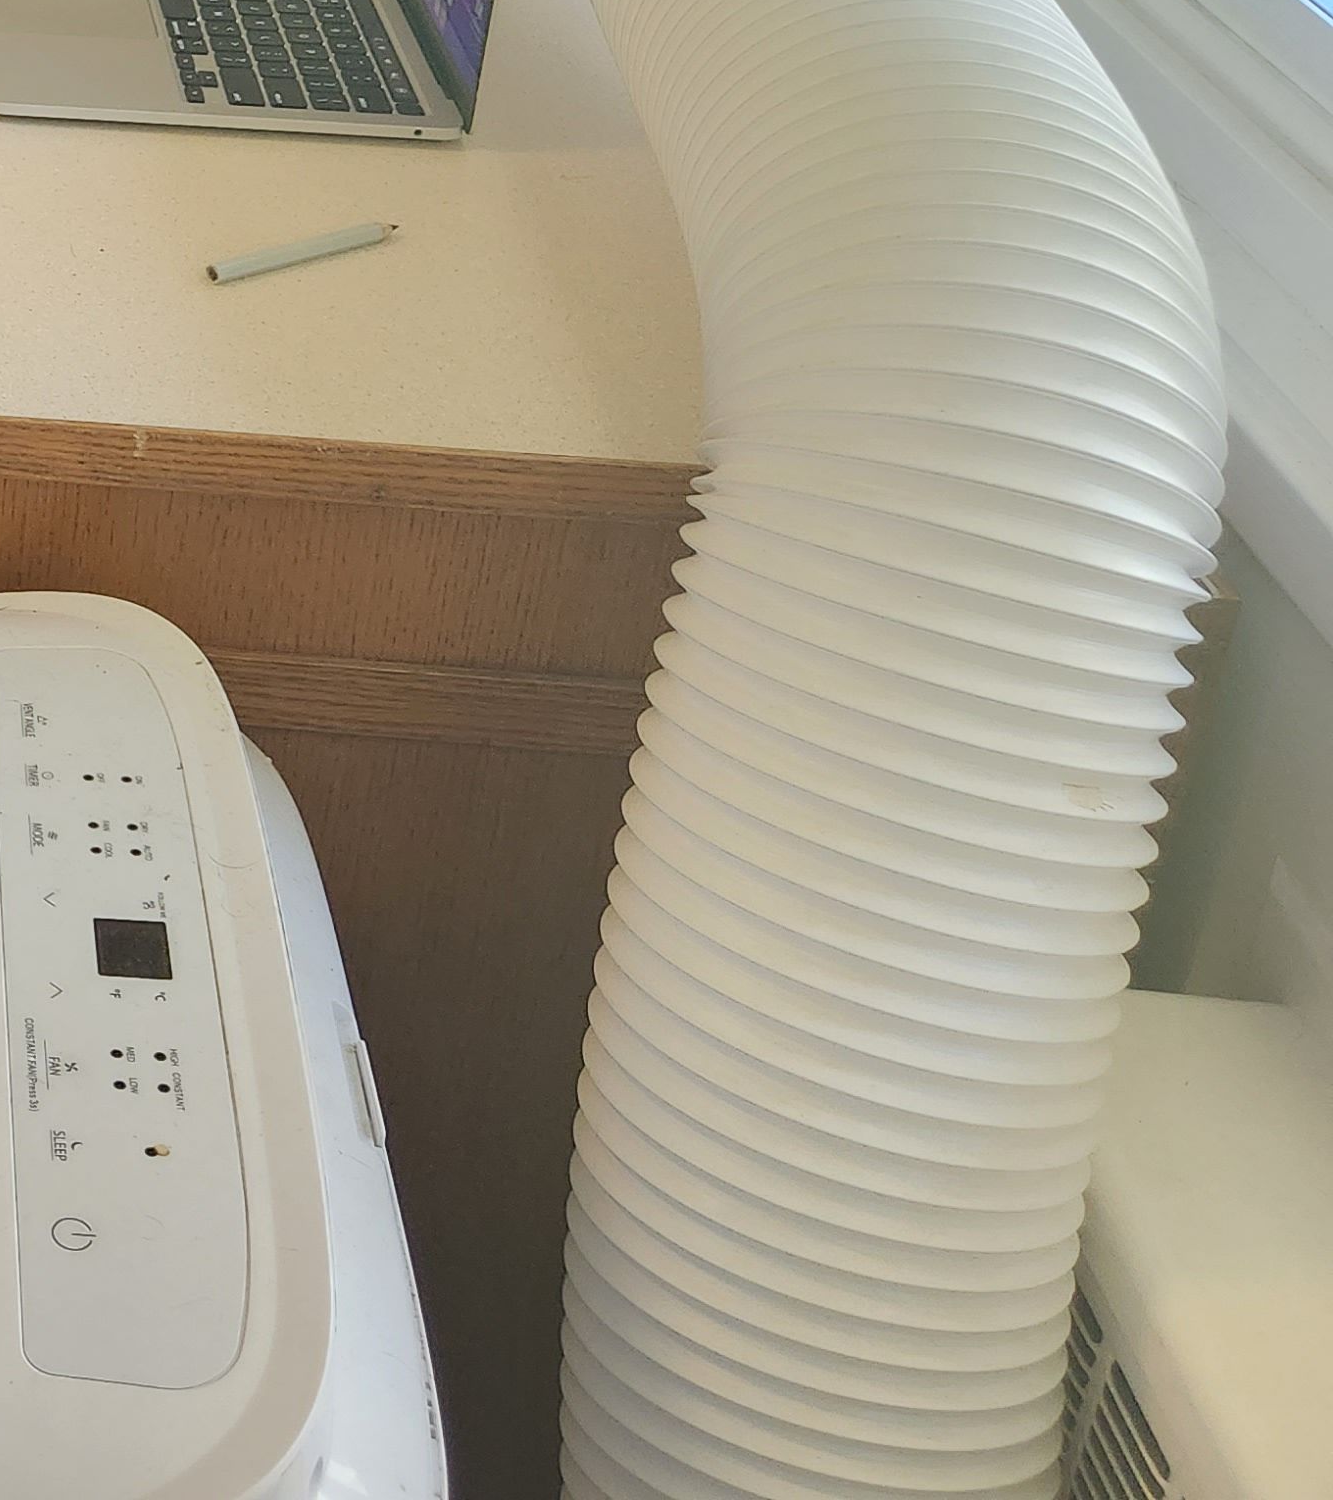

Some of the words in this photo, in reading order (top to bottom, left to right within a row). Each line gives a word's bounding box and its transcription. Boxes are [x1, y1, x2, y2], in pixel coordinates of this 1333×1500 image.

[22, 702, 33, 718] VENT
[23, 718, 34, 738] ANGLE
[27, 765, 39, 787] TIMER
[32, 823, 44, 847] MODE
[24, 1018, 37, 1059] CONSTANT
[126, 1047, 136, 1063] MED
[169, 1048, 179, 1066] HIGH
[48, 1056, 61, 1076] FAN
[128, 1077, 139, 1095] LOW
[172, 1072, 185, 1112] CONSTANT
[28, 1099, 39, 1112] 3s)
[53, 1130, 67, 1162] SLEEP
